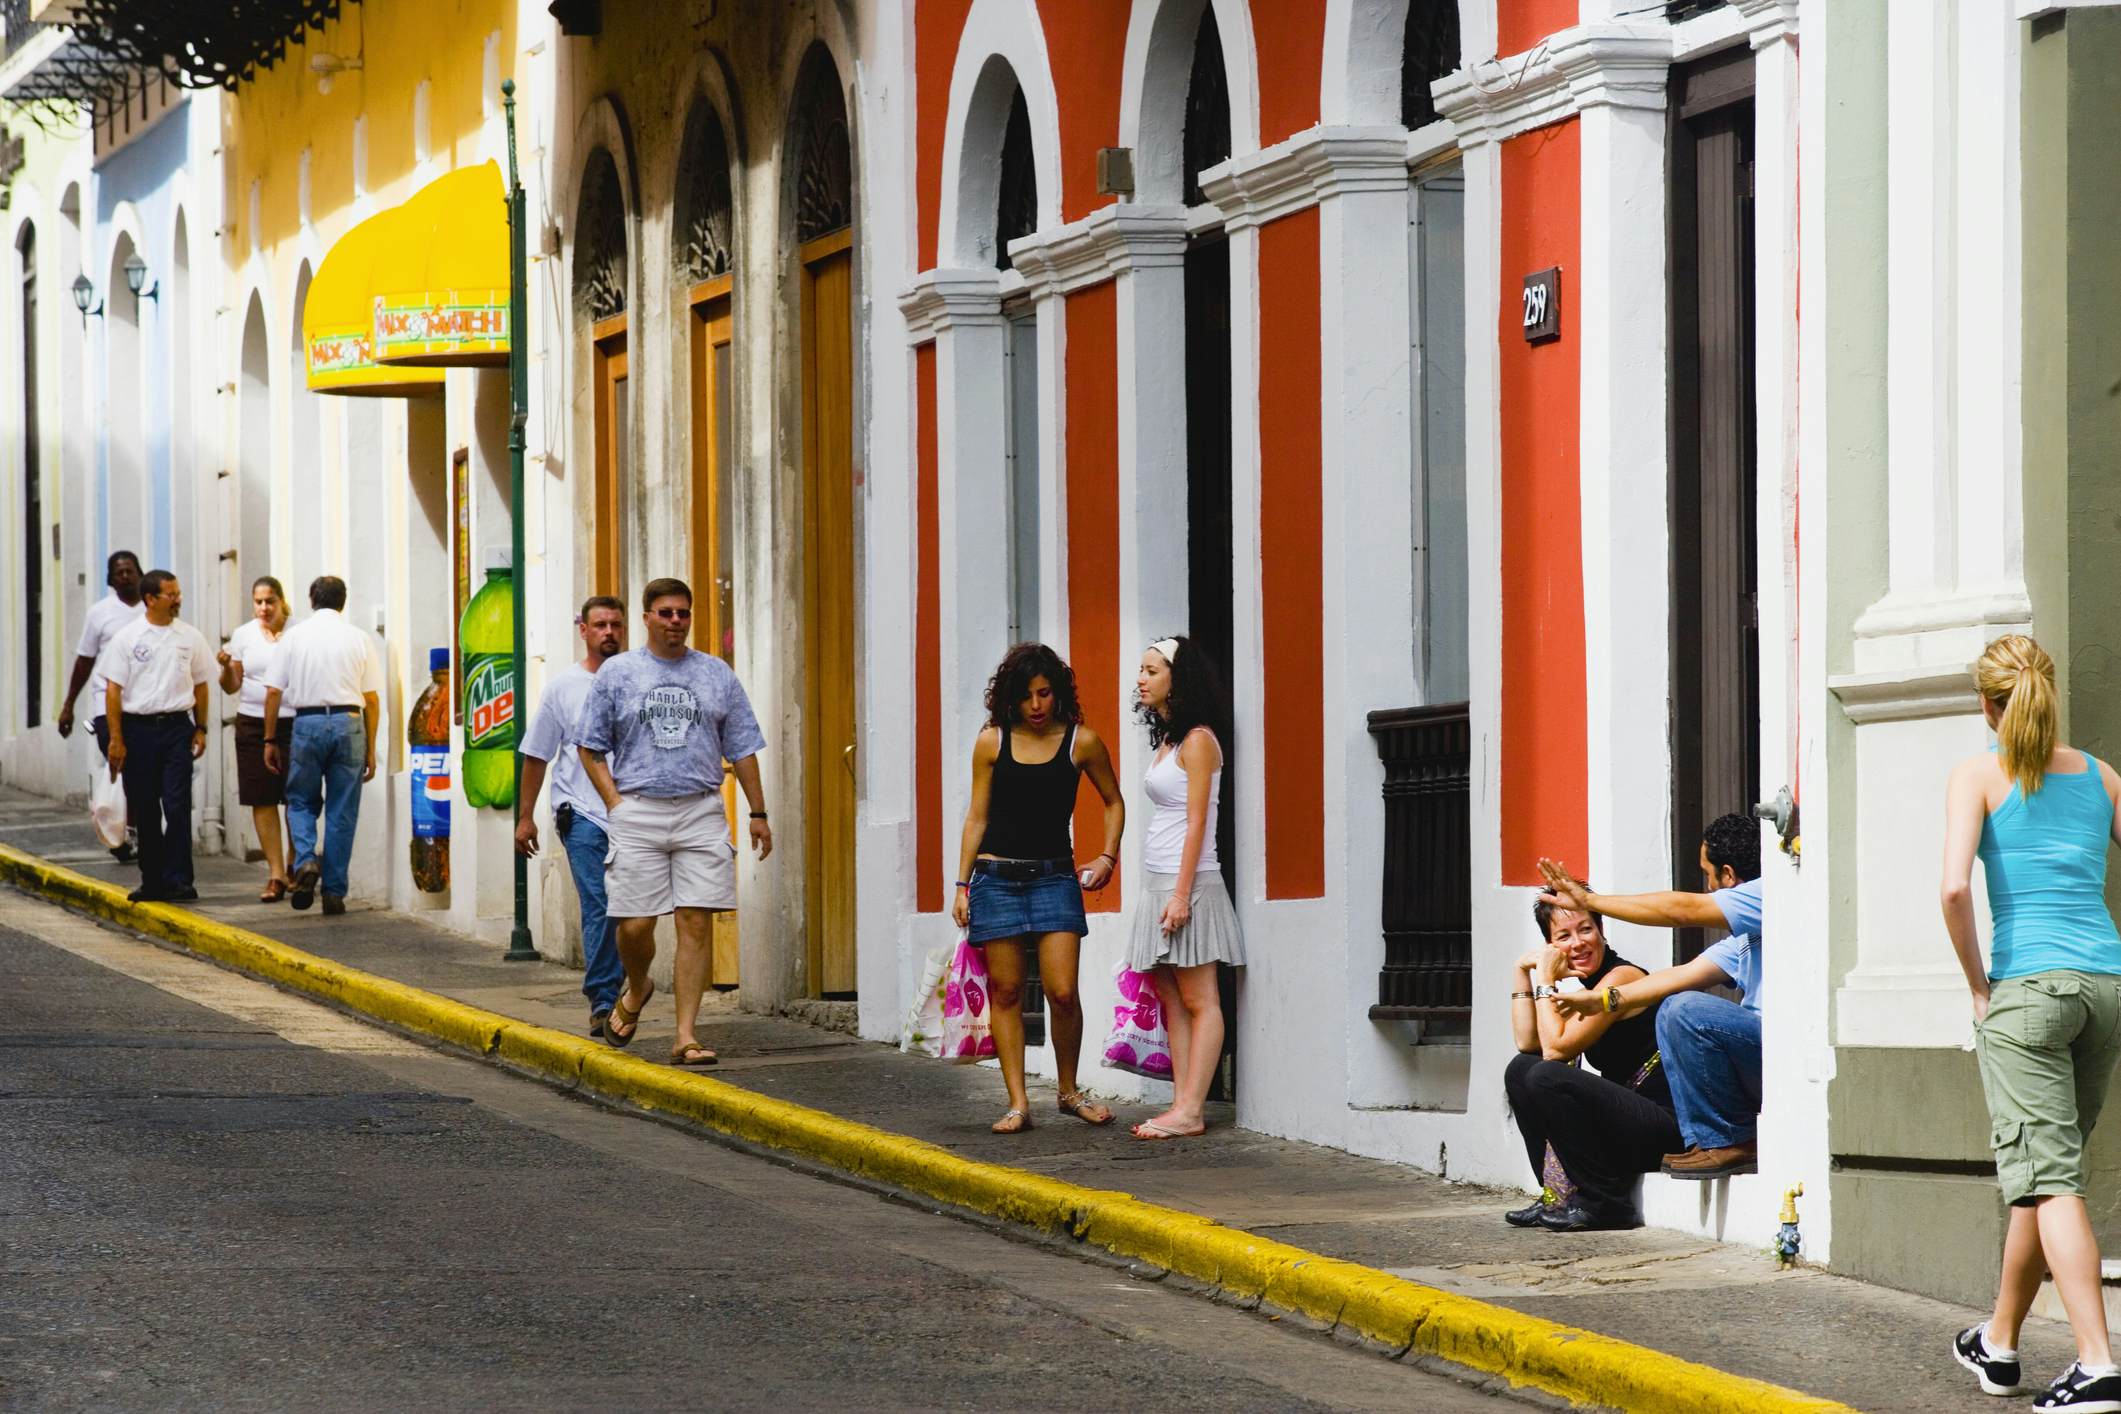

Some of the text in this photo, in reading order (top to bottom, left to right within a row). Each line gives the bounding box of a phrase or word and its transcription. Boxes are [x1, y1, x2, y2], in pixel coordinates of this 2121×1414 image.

[1523, 284, 1546, 326] 259
[649, 690, 692, 704] HARLEY
[472, 688, 514, 741] De
[640, 706, 702, 725] DAVIDSON
